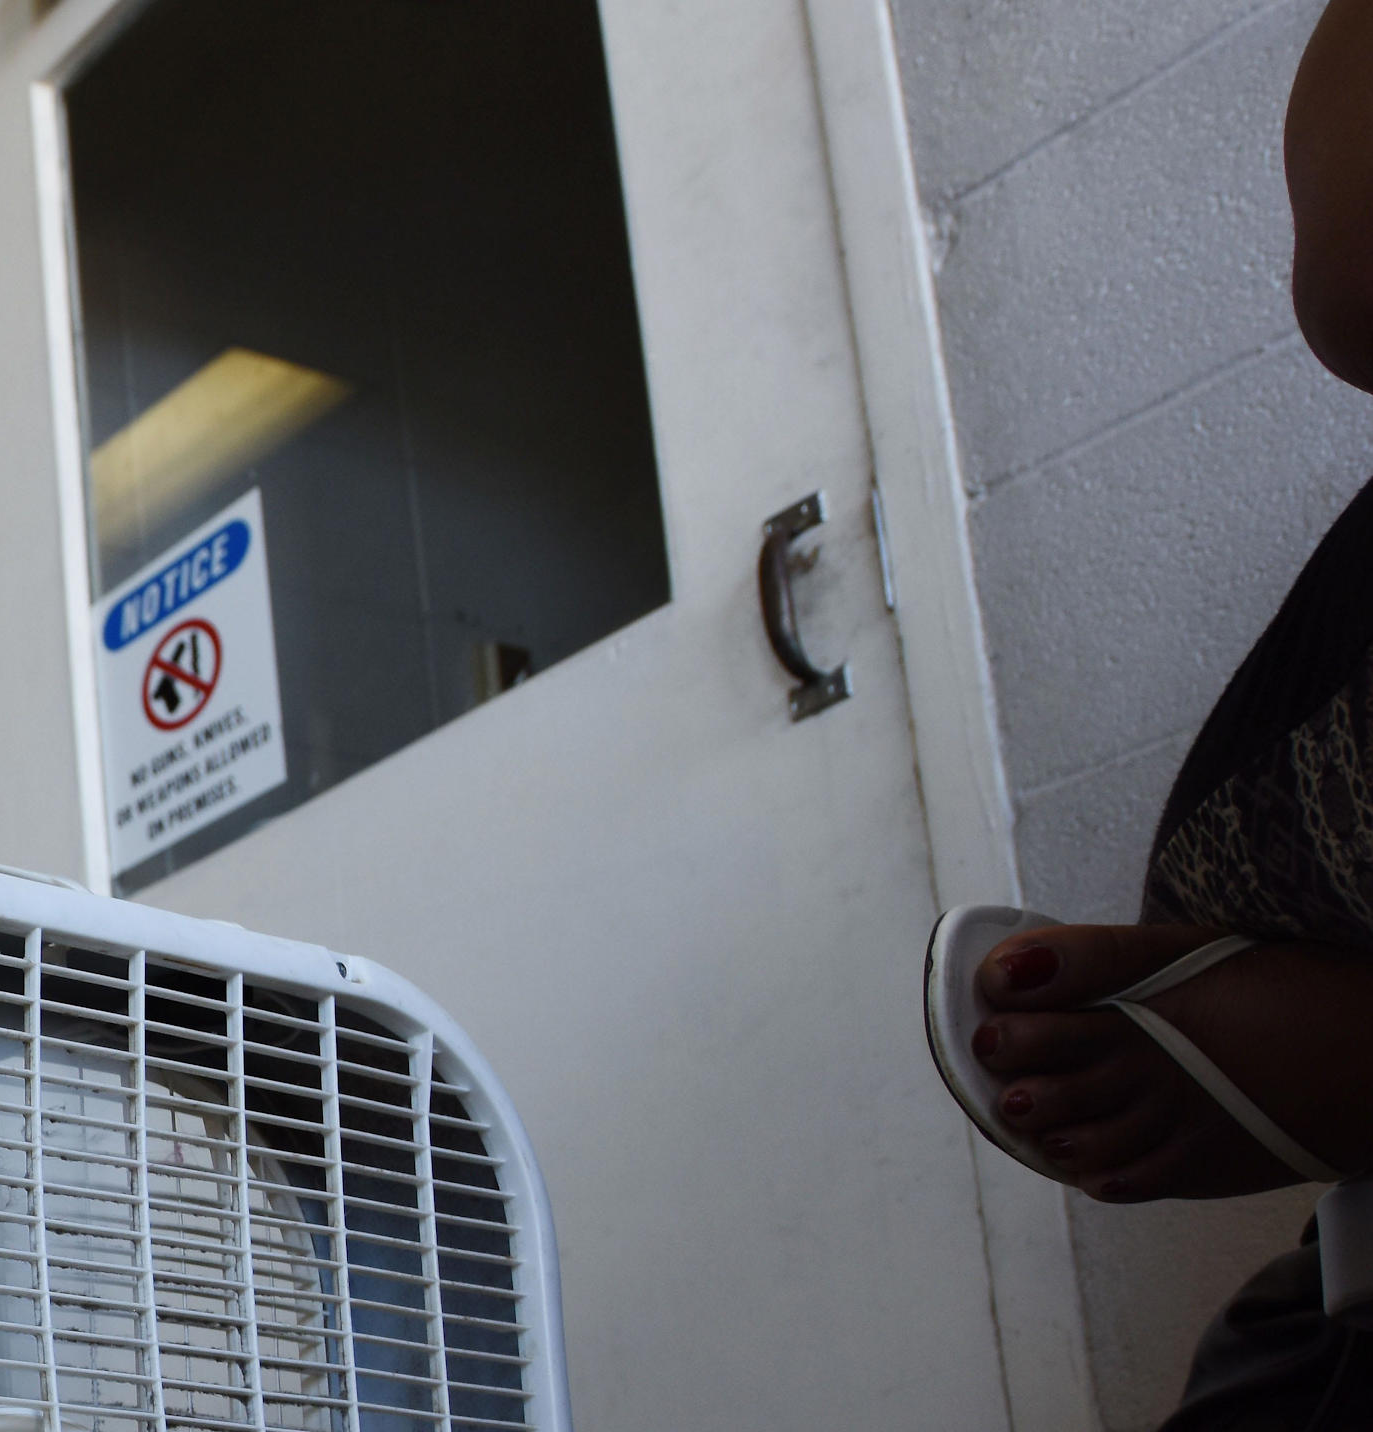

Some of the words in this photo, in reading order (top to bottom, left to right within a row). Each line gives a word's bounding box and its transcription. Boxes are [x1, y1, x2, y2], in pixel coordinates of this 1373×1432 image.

[119, 532, 230, 642] NOTICE
[130, 765, 147, 788] NO
[136, 763, 200, 814] WEAPONS
[205, 722, 271, 775] ALLOWED
